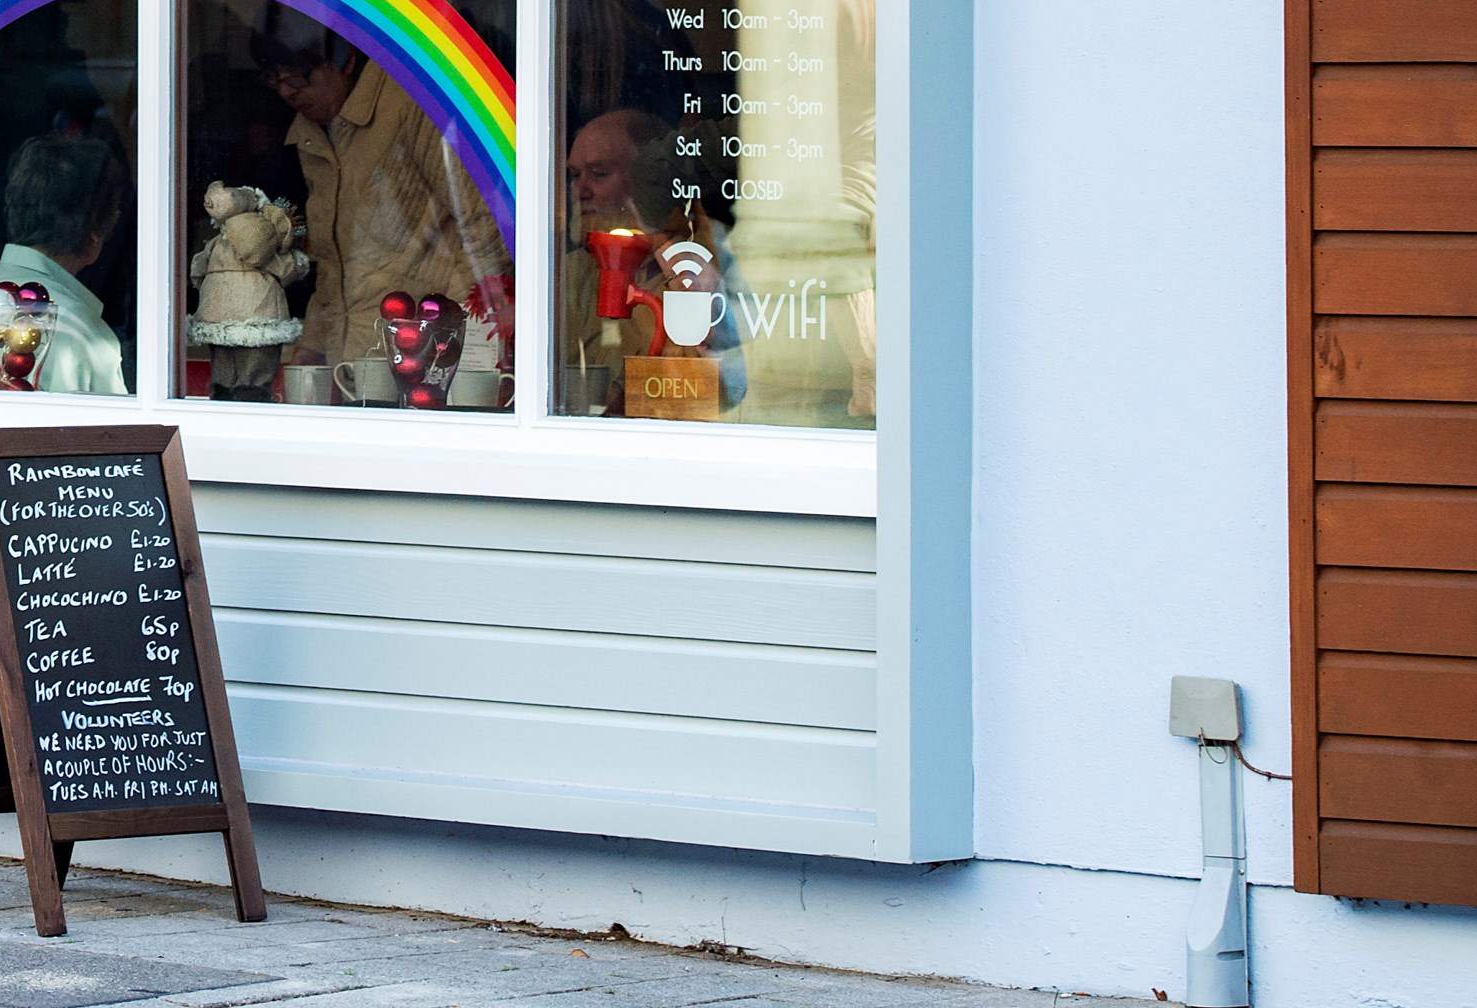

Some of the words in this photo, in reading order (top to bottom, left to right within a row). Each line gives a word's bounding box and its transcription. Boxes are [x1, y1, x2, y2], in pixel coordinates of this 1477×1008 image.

[665, 8, 704, 30] Wed
[721, 8, 767, 30] 10am
[787, 8, 824, 33] 3pm
[662, 50, 702, 72] Thurs
[721, 50, 767, 72] 10am
[787, 51, 824, 76] 3pm
[683, 93, 701, 115] Fri
[721, 93, 767, 115] 10am
[787, 94, 824, 119] 3pm
[676, 135, 701, 157] Sat
[721, 135, 767, 157] 10am
[787, 137, 824, 162] 3pm
[672, 178, 701, 200] Sun
[721, 179, 783, 200] CLOSED
[737, 278, 827, 340] wifi
[645, 377, 698, 399] OPEN
[7, 463, 100, 486] RAINBOW
[104, 459, 144, 478] CAFÉ
[58, 485, 113, 501] MENU
[0, 499, 46, 525] (FOR
[48, 502, 75, 518] THE
[78, 502, 124, 518] OVER
[8, 533, 112, 558] CAPPUCINO
[17, 590, 127, 611] CHOCOCHINO
[24, 618, 67, 643] TEA
[141, 615, 179, 637] 65p
[26, 646, 95, 673] COFFEE
[146, 640, 180, 665] 80p
[35, 679, 62, 702] HOT
[66, 678, 150, 697] CHOCOLATE
[159, 676, 194, 702] 70p
[61, 709, 175, 730] VOLUNTEERS
[39, 733, 61, 752] WE
[65, 733, 106, 751] NEED
[110, 734, 138, 751] YOU
[142, 733, 171, 748] FOR
[173, 730, 206, 746] JUST
[44, 758, 54, 775] A
[55, 757, 109, 778] COUPLE
[112, 755, 131, 774] OF
[49, 781, 88, 801] TUES
[124, 780, 145, 799] FRI
[175, 779, 198, 796] SAT
